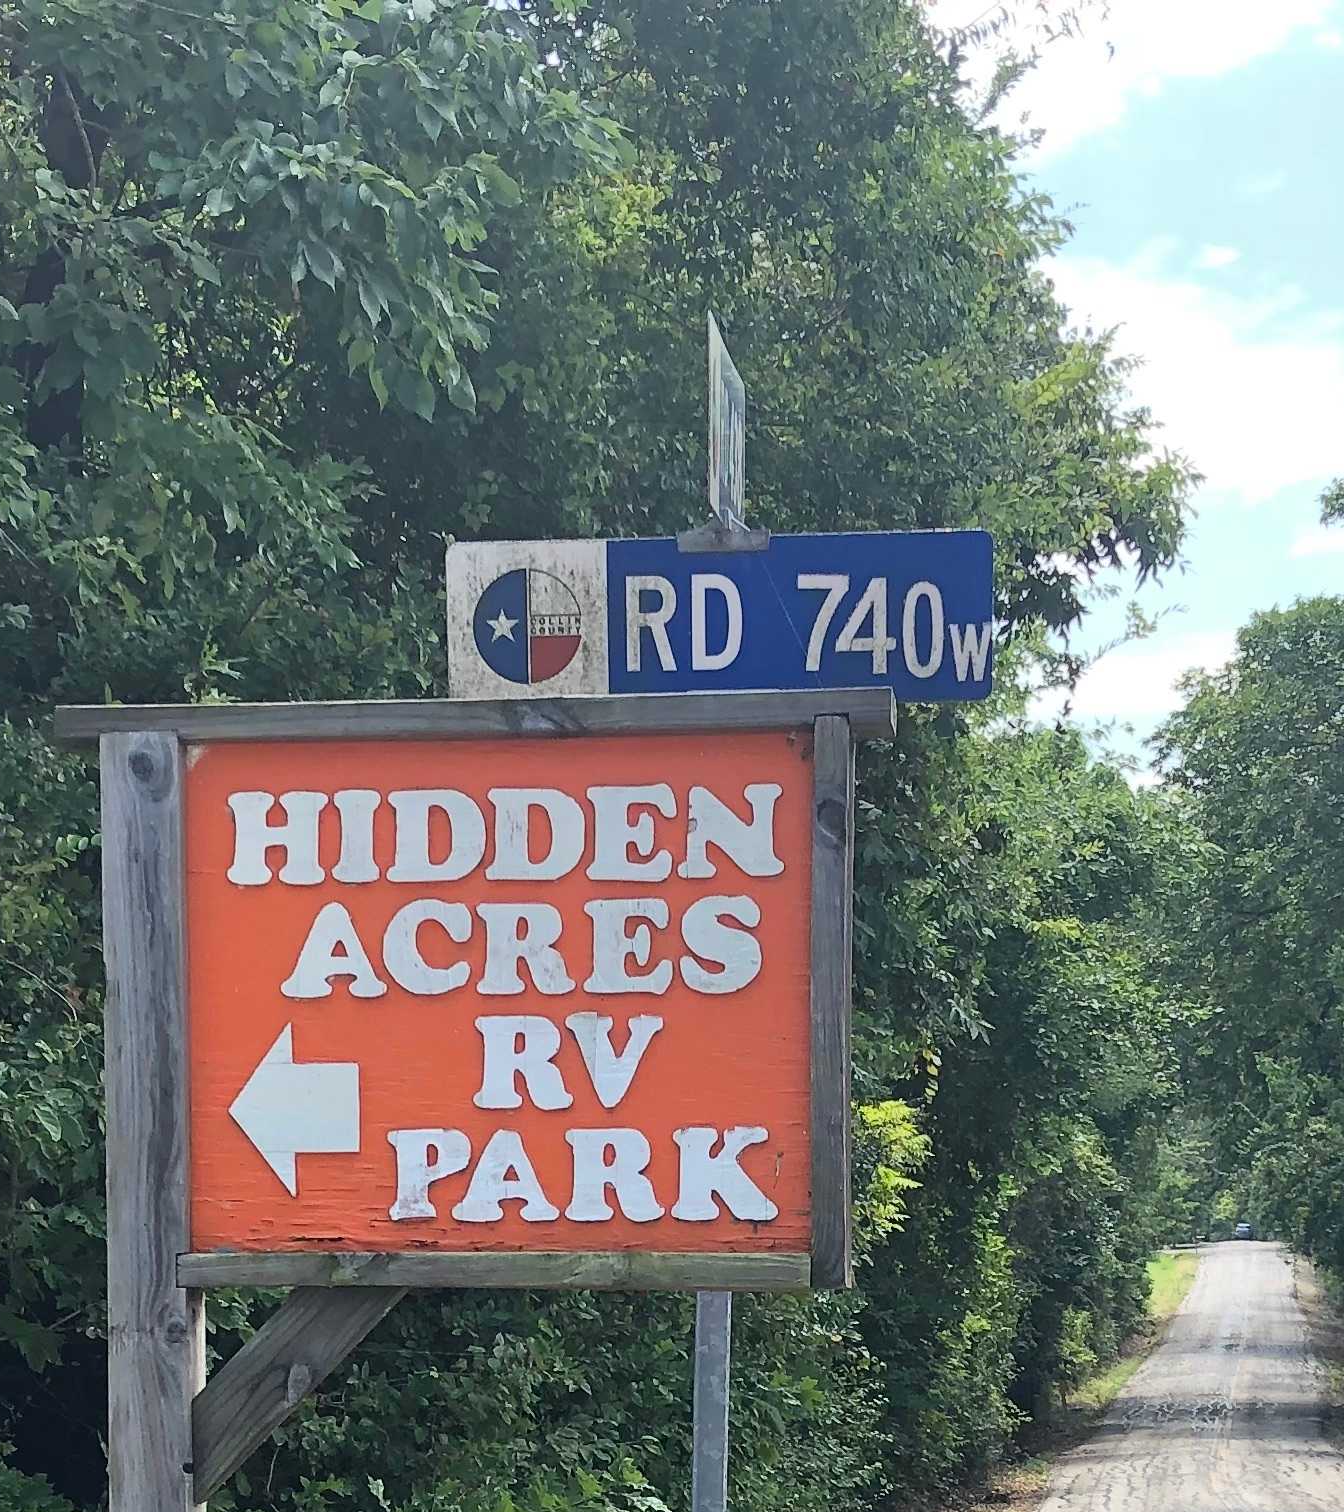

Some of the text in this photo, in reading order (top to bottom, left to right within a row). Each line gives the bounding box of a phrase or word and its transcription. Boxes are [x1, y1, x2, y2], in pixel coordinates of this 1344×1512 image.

[530, 616, 582, 626] COLLIN
[530, 626, 582, 635] COUNTY
[625, 573, 744, 674] RD
[227, 783, 786, 886] HIDDEN
[280, 895, 764, 999] ACRES
[473, 1011, 664, 1111] RV
[386, 1126, 780, 1222] PARK
